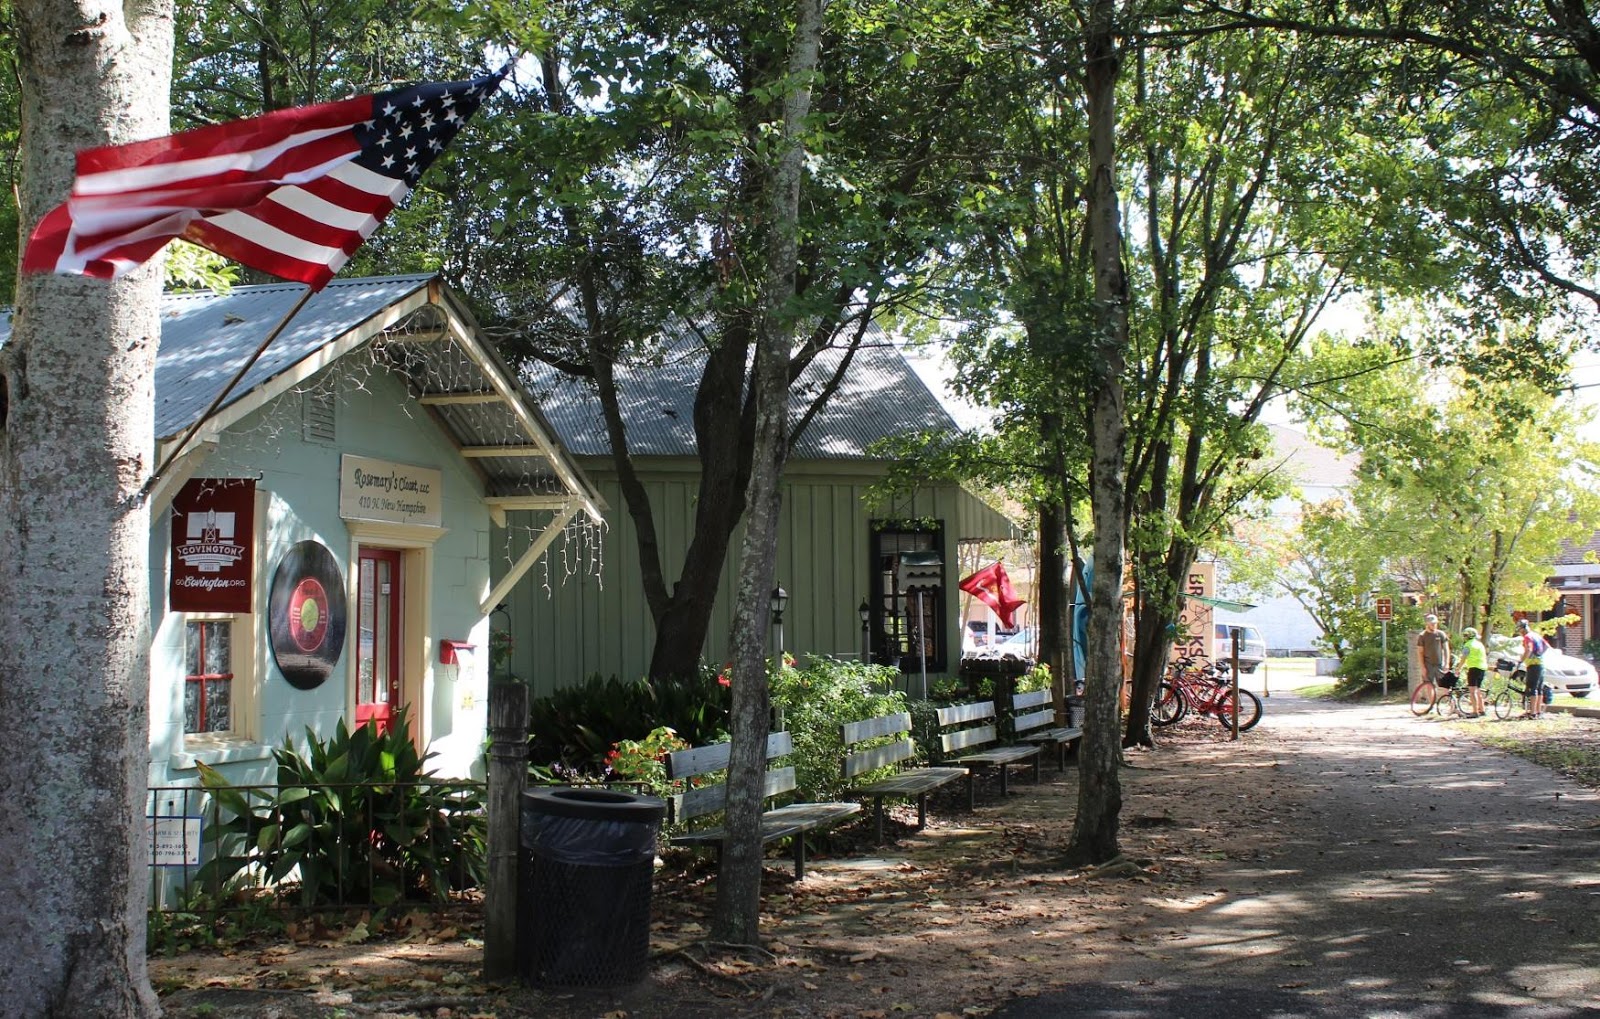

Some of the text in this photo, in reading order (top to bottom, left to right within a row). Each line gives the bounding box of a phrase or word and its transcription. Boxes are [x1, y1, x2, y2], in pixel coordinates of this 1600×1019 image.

[354, 468, 398, 492] Rosemary's
[400, 477, 418, 494] Closet,
[358, 496, 370, 508] 410
[381, 498, 396, 510] New
[396, 500, 426, 516] Hampshire
[182, 545, 237, 556] COVINGTON
